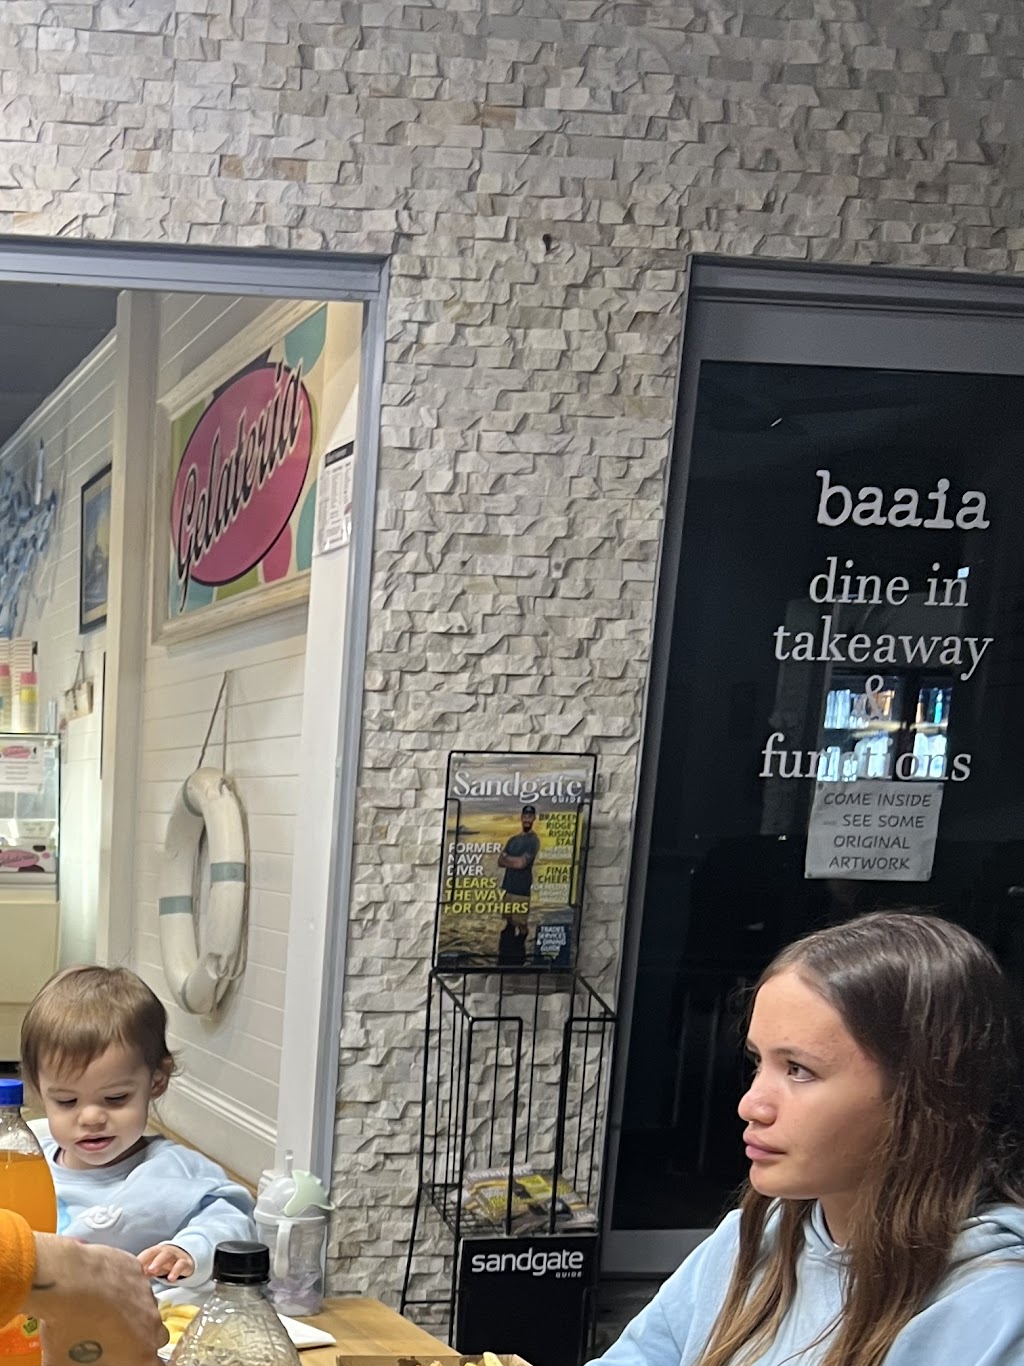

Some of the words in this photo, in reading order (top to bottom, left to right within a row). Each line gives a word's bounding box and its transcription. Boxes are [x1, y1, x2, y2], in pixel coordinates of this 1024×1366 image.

[176, 356, 304, 615] Gelateria
[816, 469, 991, 530] baaia
[808, 556, 910, 606] dine
[925, 562, 969, 608] in
[772, 615, 994, 681] takeaway
[863, 674, 893, 721] &
[758, 732, 972, 783] functions
[453, 771, 582, 803] Sandgate
[823, 792, 873, 806] COME
[877, 793, 932, 807] INSIDE
[842, 813, 873, 827] SEE
[878, 815, 926, 829] SOME
[449, 843, 501, 853] FORMER
[833, 835, 911, 849] ORIGINAL
[828, 856, 910, 870] ARTWORK
[474, 890, 507, 901] WAY
[475, 903, 529, 914] OTHERS
[471, 1248, 584, 1277] sandgate
